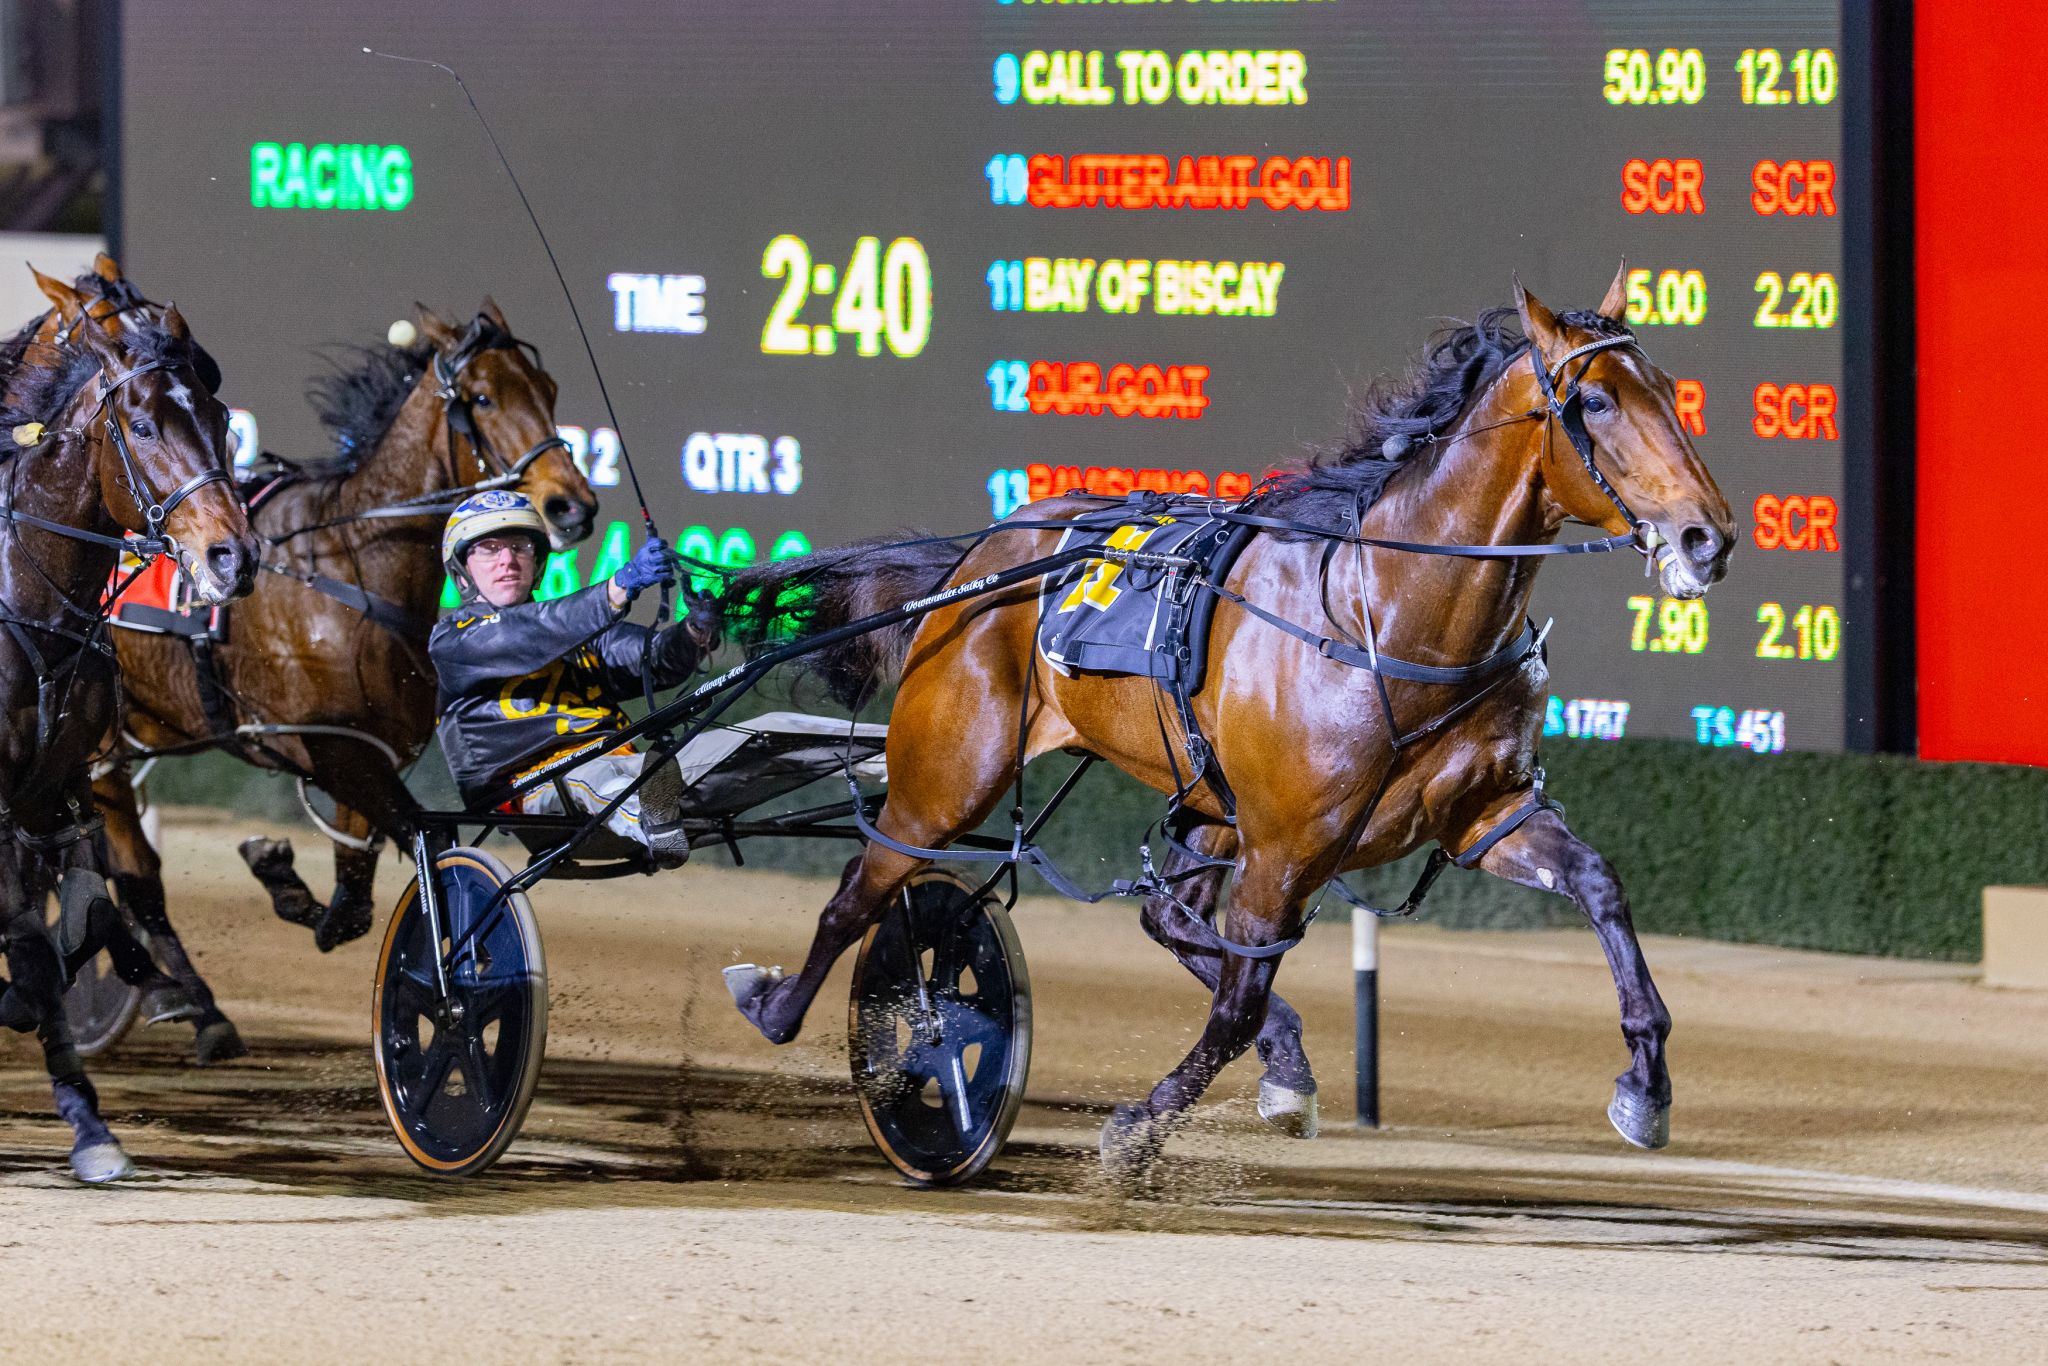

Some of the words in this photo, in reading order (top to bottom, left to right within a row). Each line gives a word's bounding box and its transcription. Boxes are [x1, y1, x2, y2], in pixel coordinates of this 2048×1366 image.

[993, 53, 1020, 104] 9
[1021, 50, 1115, 105] CALL
[1116, 50, 1172, 105] TO
[1176, 50, 1308, 105] ORDER
[1603, 48, 1706, 104] 50.90
[1735, 48, 1839, 105] 12.10
[250, 142, 413, 211] RACING
[985, 154, 1028, 205] 10
[1027, 154, 1170, 209] GLITTER
[1621, 159, 1705, 214] SCR
[1751, 160, 1837, 216] SCR
[607, 273, 706, 334] TIME
[760, 234, 933, 358] 2:40
[985, 260, 1024, 312] 11
[1023, 257, 1096, 313] BAY
[1096, 259, 1151, 314] OF
[1153, 261, 1286, 316] BISCAY
[1754, 271, 1839, 329] 2.20
[986, 360, 1029, 411] 12
[1026, 361, 1103, 416] OUR
[1106, 363, 1210, 420] GOAT
[1753, 382, 1839, 440] SCR
[589, 427, 621, 488] 2
[680, 431, 771, 494] QTR
[769, 435, 804, 496] 3
[1753, 493, 1840, 552] SCR
[1627, 595, 1710, 654] 7.90
[1756, 602, 1841, 661] 2.10
